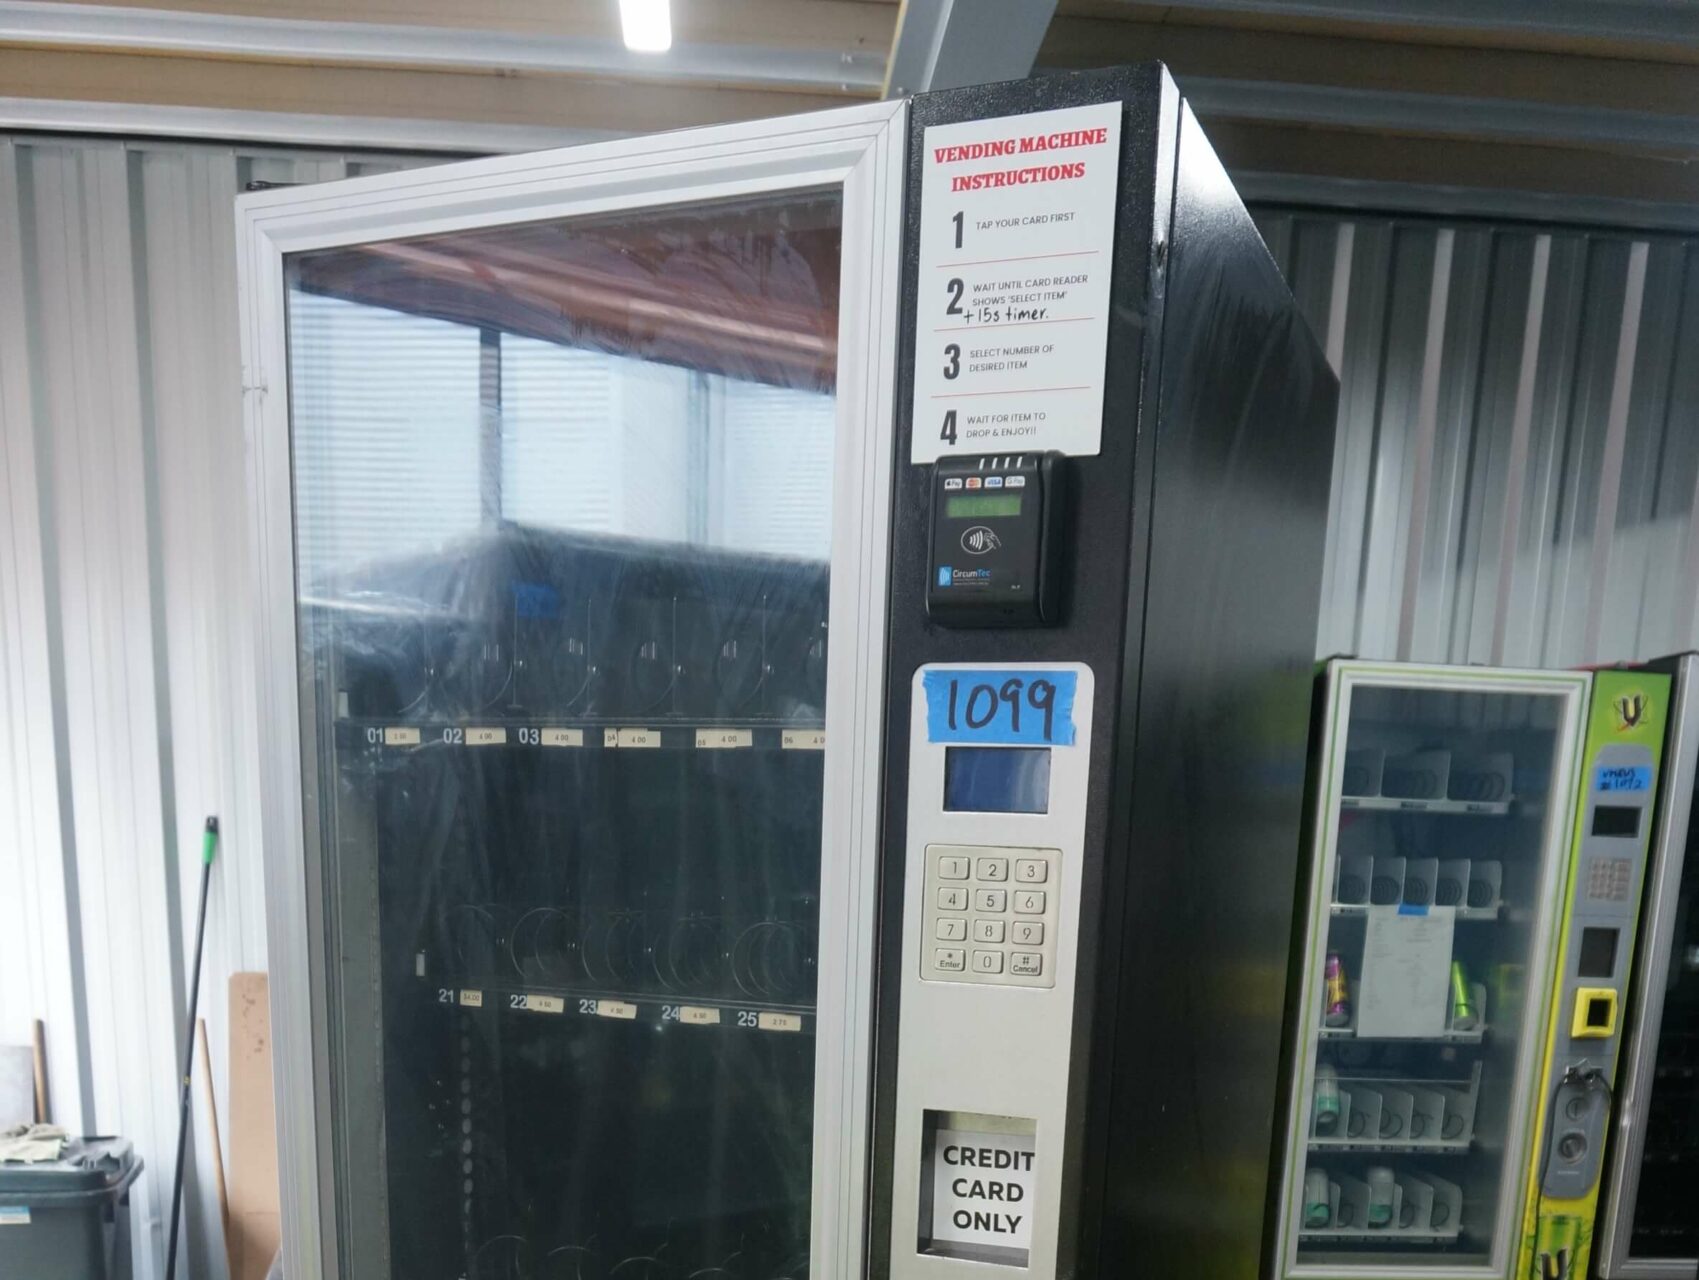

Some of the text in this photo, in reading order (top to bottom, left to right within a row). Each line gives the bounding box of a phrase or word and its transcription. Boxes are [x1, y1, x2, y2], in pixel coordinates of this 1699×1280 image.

[934, 128, 1108, 164] VENDING MACHINE
[951, 162, 1086, 192] INSTRUCTIONS
[952, 210, 1075, 249] 1 TAP YOUR CARD FIRST
[946, 274, 1088, 315] 2 WAIT UNTIL CARD READER
[972, 295, 1006, 306] SHOWS
[943, 343, 1055, 380] 3 SELECT NUMBER OF
[969, 360, 1028, 373] DESIRED ITEM
[940, 409, 1046, 446] 4 WAIT FOR ITEM TO
[966, 426, 1037, 439] DROP & ENJOY!!
[948, 678, 1056, 741] 1099
[367, 727, 384, 744] 01
[443, 728, 462, 744] 02
[518, 728, 539, 745] 03
[953, 861, 957, 874] 1
[988, 863, 997, 877] 2
[1027, 865, 1035, 878] 3
[948, 892, 956, 906] 4
[986, 894, 995, 908] 5
[1025, 896, 1034, 909] 6
[947, 924, 954, 937] 7
[984, 925, 993, 937] 8
[1023, 927, 1032, 940] 9
[939, 960, 961, 969] Enter
[983, 956, 992, 969] 0
[1013, 965, 1038, 974] Cancel
[438, 988, 454, 1003] 21
[510, 994, 528, 1009] 22
[579, 1000, 597, 1015] 23
[661, 1005, 680, 1020] 24
[737, 1011, 757, 1027] 25
[943, 1145, 1035, 1171] CREDIT
[952, 1178, 1024, 1202] CARD
[953, 1209, 1022, 1234] ONLY
